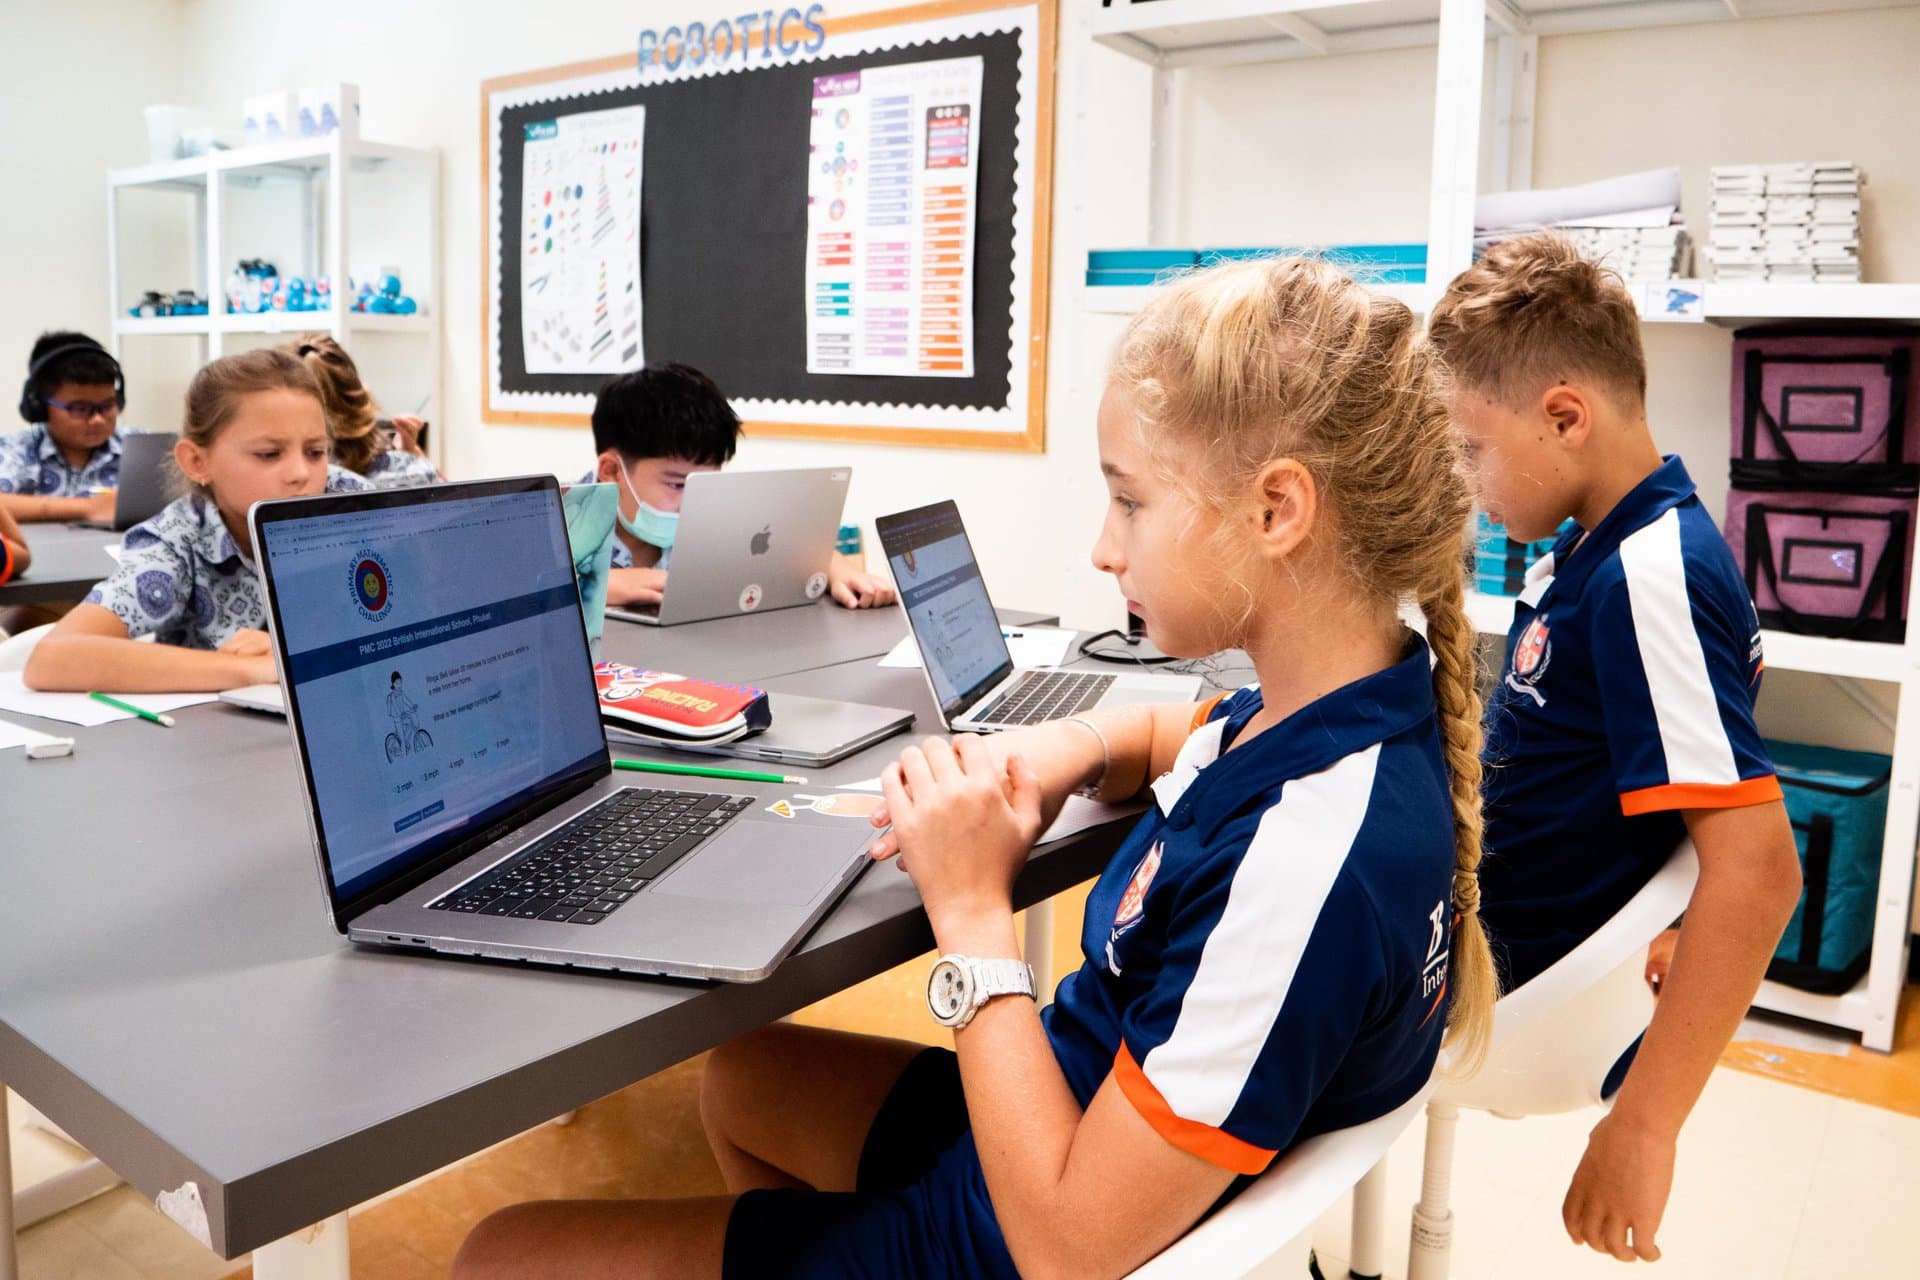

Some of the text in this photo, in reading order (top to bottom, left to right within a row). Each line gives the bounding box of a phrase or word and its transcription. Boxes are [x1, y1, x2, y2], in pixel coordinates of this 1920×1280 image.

[638, 3, 826, 73] ROBOTICS
[356, 548, 394, 597] MATHEMATICS
[358, 600, 393, 623] CHALLENGE
[359, 642, 376, 656] PMC
[376, 637, 393, 650] 2022
[392, 631, 415, 646] British
[414, 621, 451, 640] International
